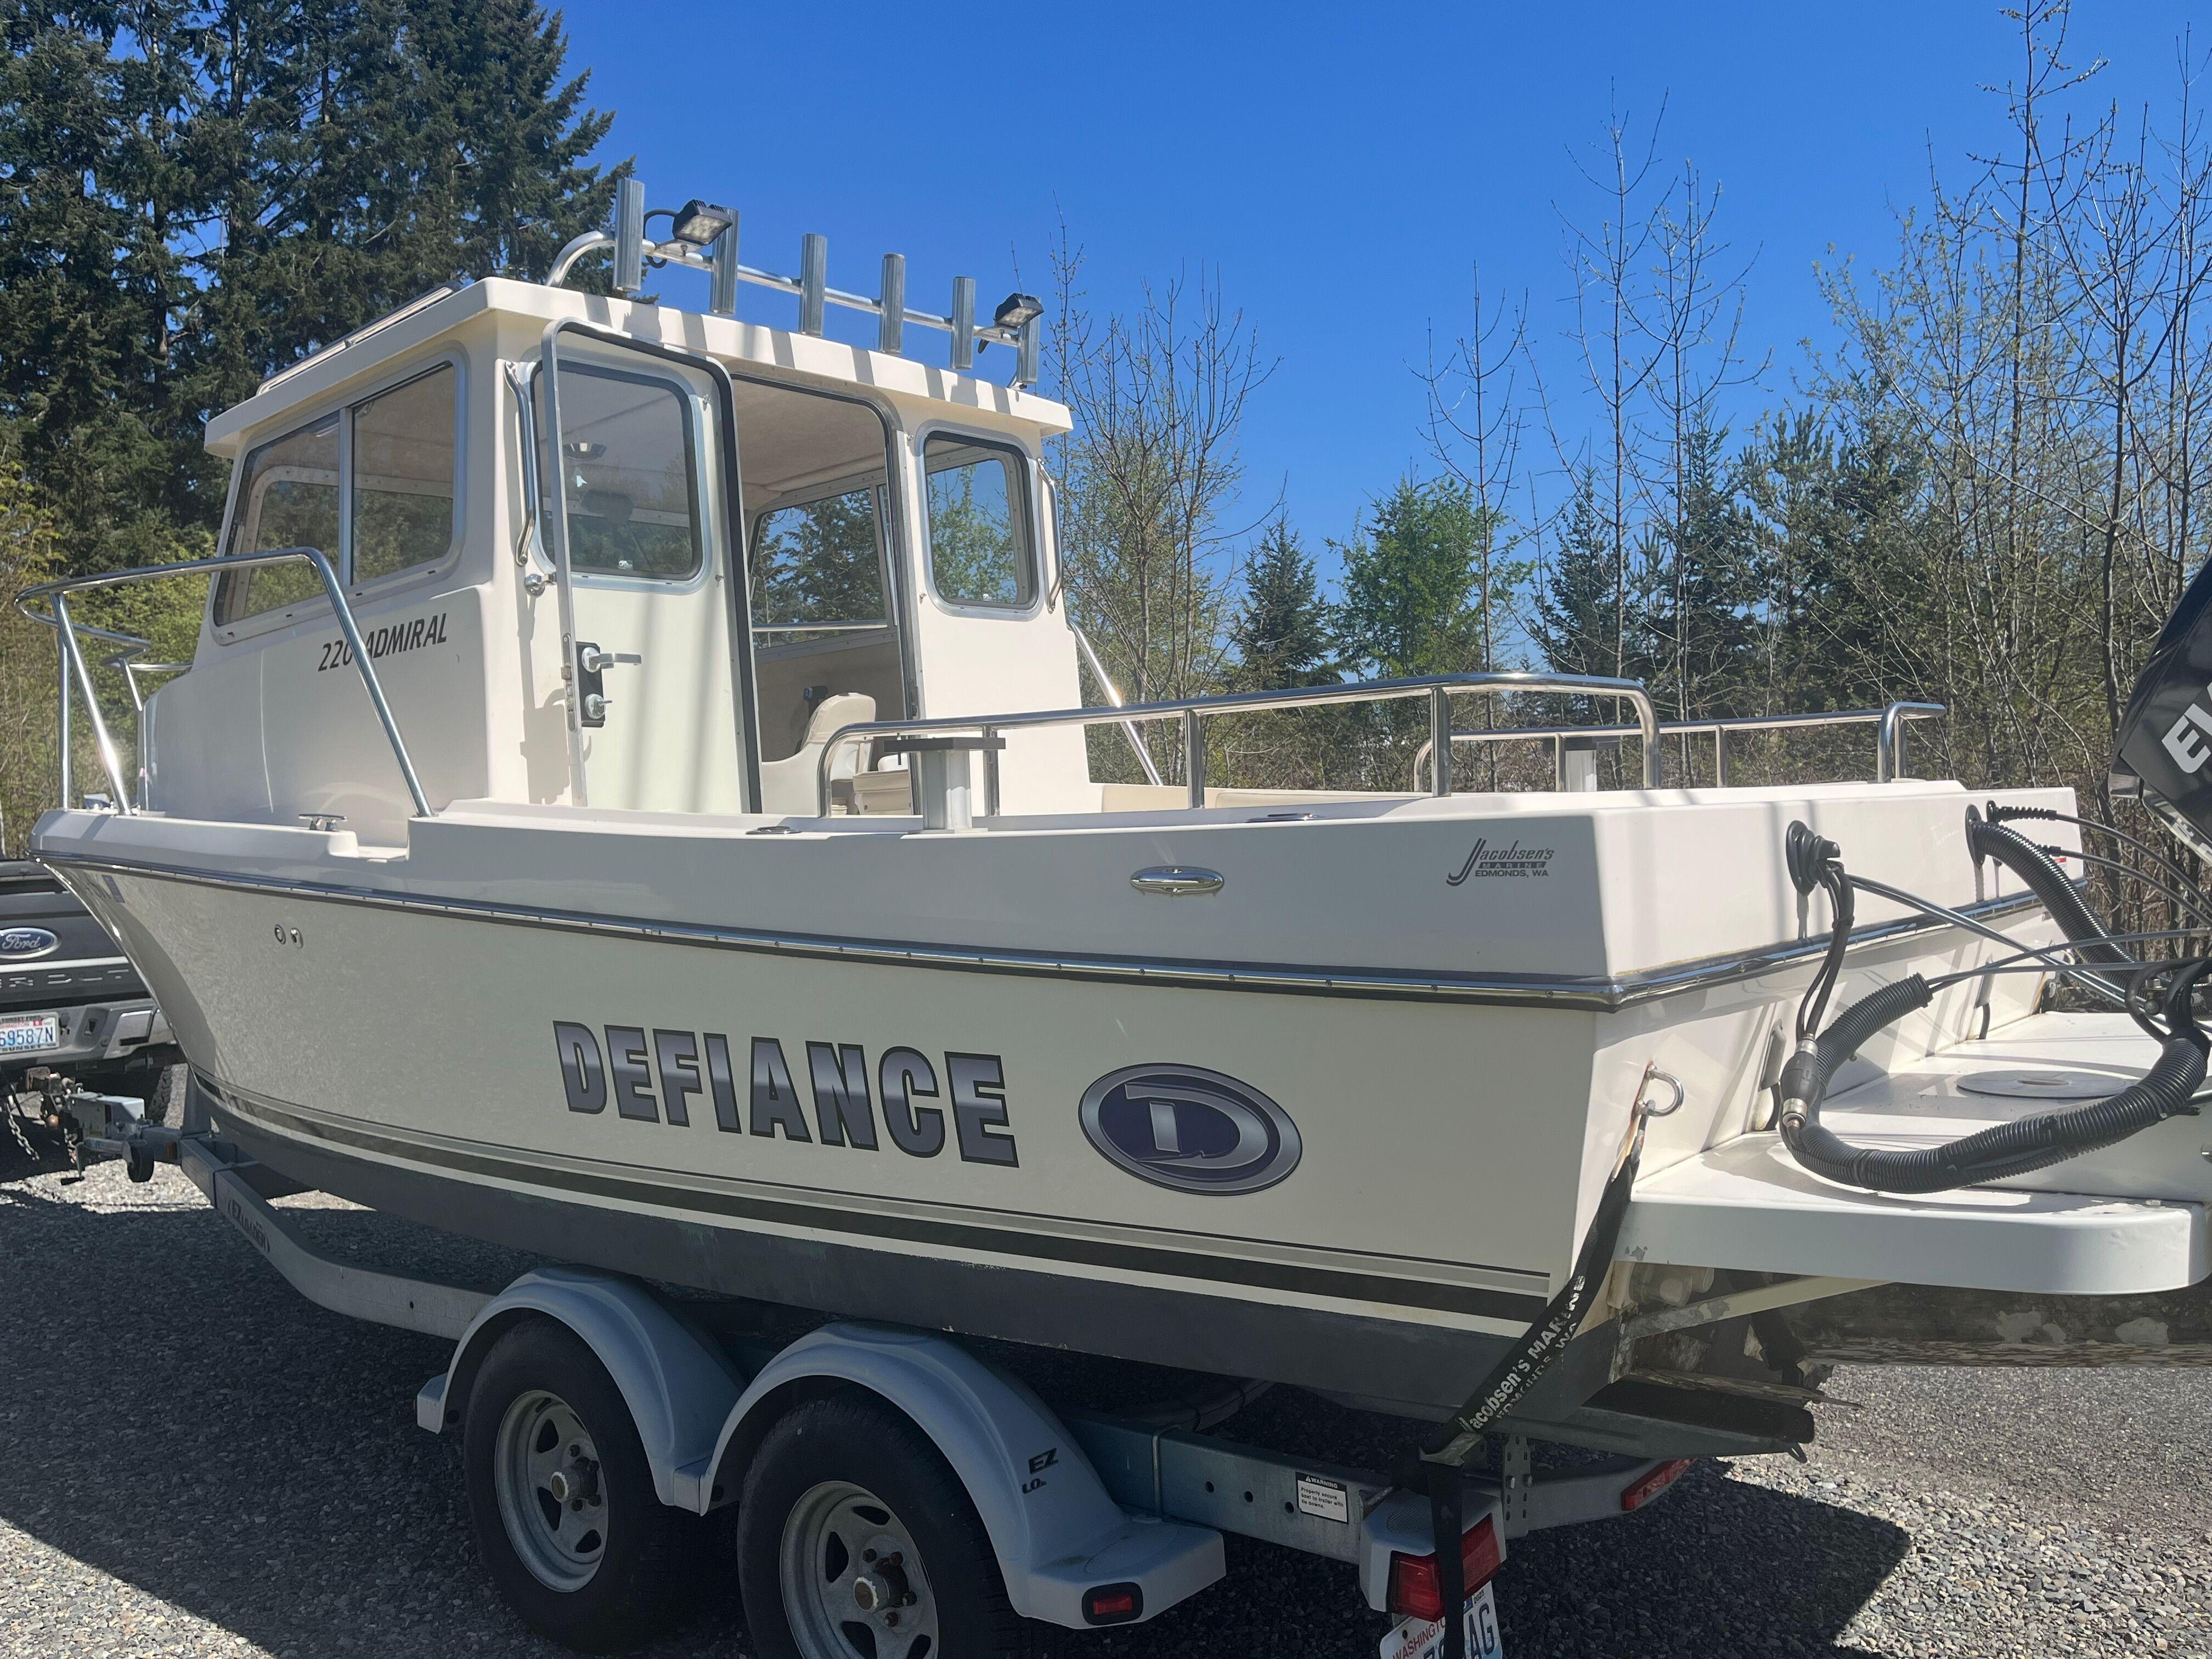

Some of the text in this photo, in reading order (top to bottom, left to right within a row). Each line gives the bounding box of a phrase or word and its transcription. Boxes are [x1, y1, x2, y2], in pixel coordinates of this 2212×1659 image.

[365, 612, 447, 659] ADMIRAL
[1446, 837, 1555, 887] Jacobsen's
[1475, 869, 1549, 878] EDMONDS, WA
[2, 933, 42, 950] Ford
[553, 1020, 1019, 1169] DEFIANCE
[1028, 1447, 1059, 1475] EZ
[1301, 1487, 1320, 1497] Properly
[1311, 1477, 1338, 1489] WARNING
[1392, 1617, 1446, 1659] WASHINGTO
